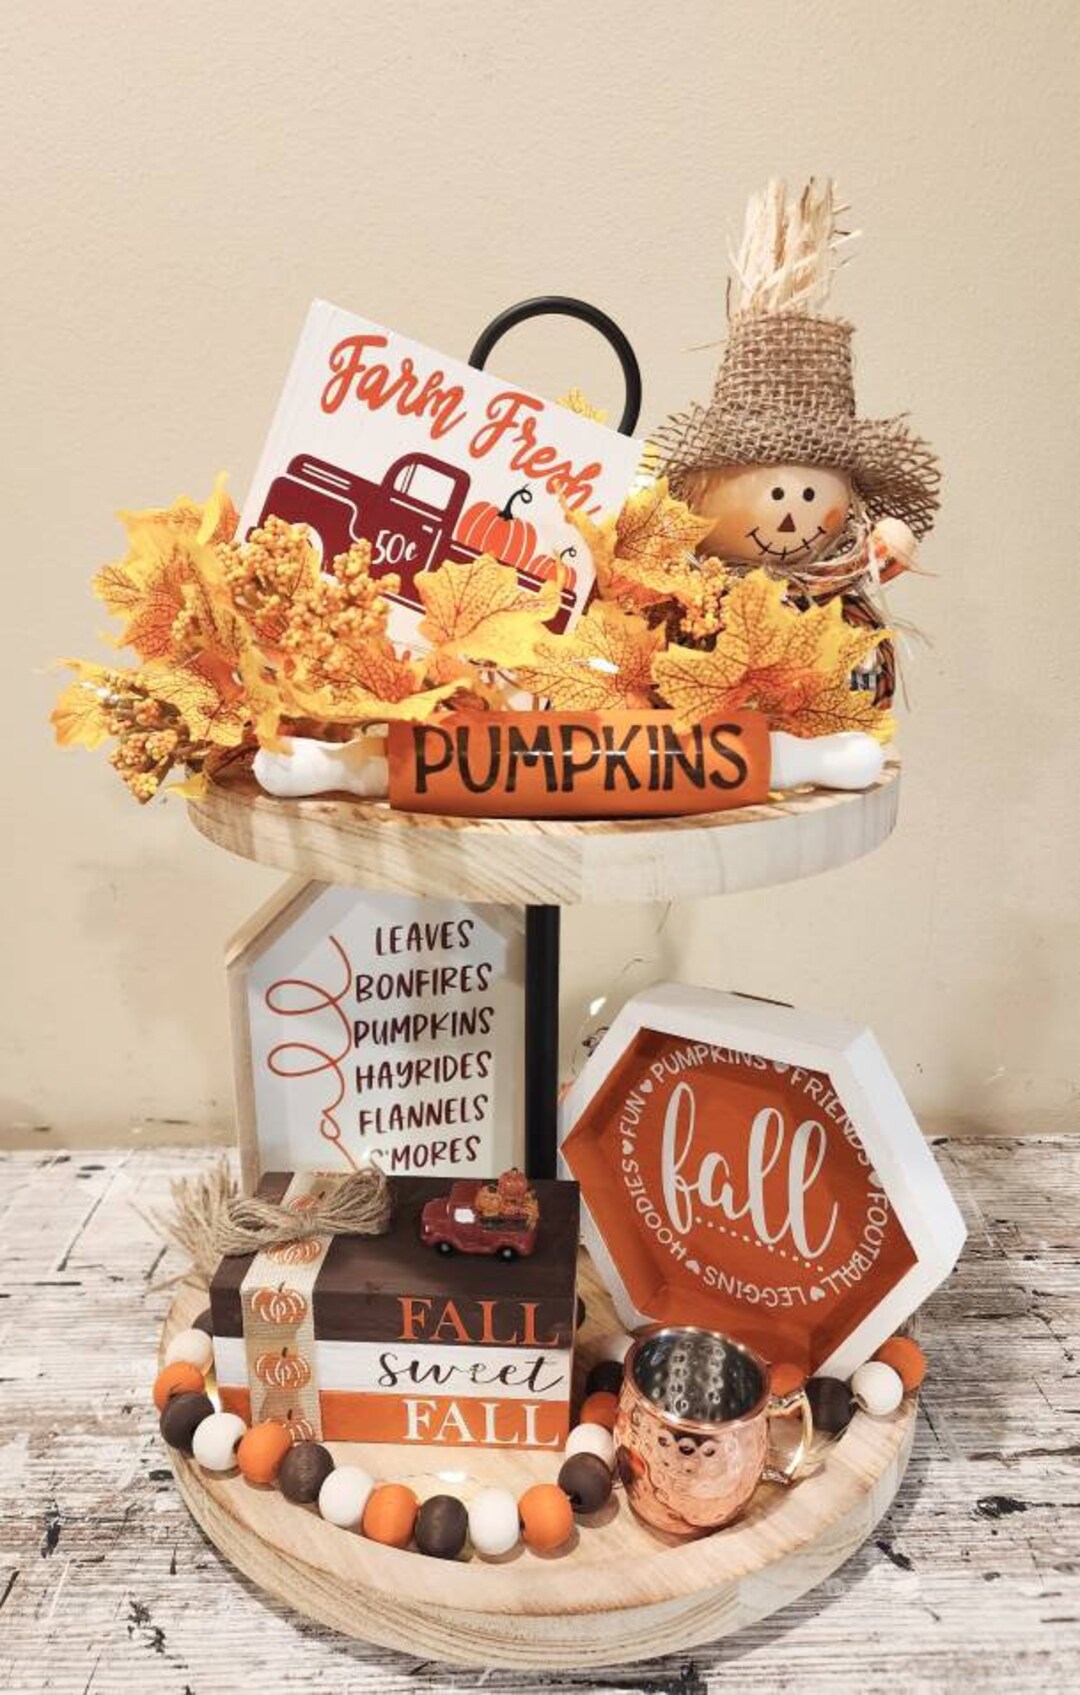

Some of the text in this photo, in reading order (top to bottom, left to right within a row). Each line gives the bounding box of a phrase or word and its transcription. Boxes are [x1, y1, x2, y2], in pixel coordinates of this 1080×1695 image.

[320, 334, 602, 515] Farm Fresh
[412, 723, 748, 793] PUMPKINS
[375, 919, 475, 956] LEAVES
[355, 962, 493, 1003] BONFIRES
[353, 1006, 494, 1048] PUMPKINS
[355, 1050, 492, 1093] HAYRIDES
[358, 1094, 488, 1136] FLANNELS
[620, 1091, 646, 1138] FUN
[661, 1081, 838, 1259] fall
[621, 1157, 687, 1261] HOODIES
[820, 1192, 889, 1295] FOOTBALL
[703, 1265, 807, 1308] LEGGINS
[397, 1297, 560, 1345] FALL
[378, 1352, 564, 1393] sweet
[402, 1398, 560, 1447] FALL
